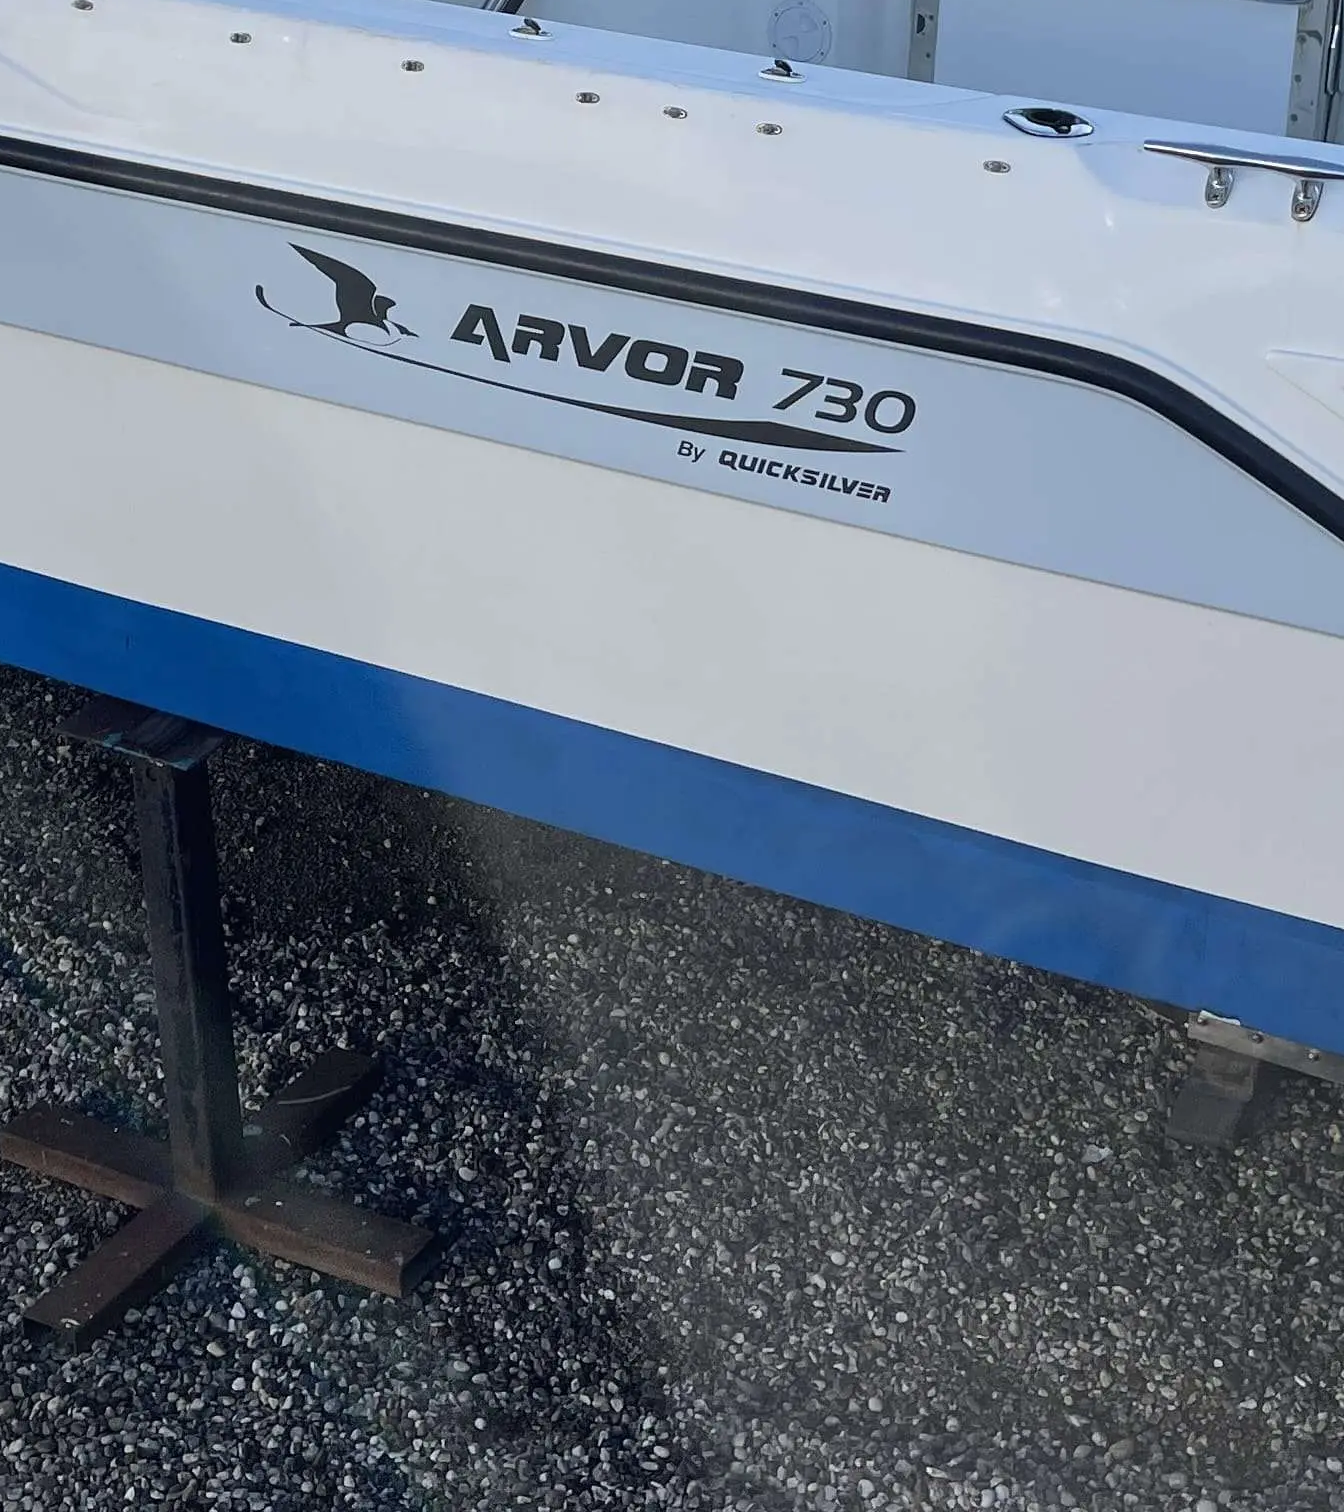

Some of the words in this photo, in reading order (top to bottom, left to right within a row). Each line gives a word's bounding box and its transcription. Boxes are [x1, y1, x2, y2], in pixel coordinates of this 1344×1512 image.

[449, 303, 746, 401] ARVOR
[772, 368, 917, 434] 730
[676, 440, 706, 463] By
[718, 449, 892, 504] QUICKSILVER
